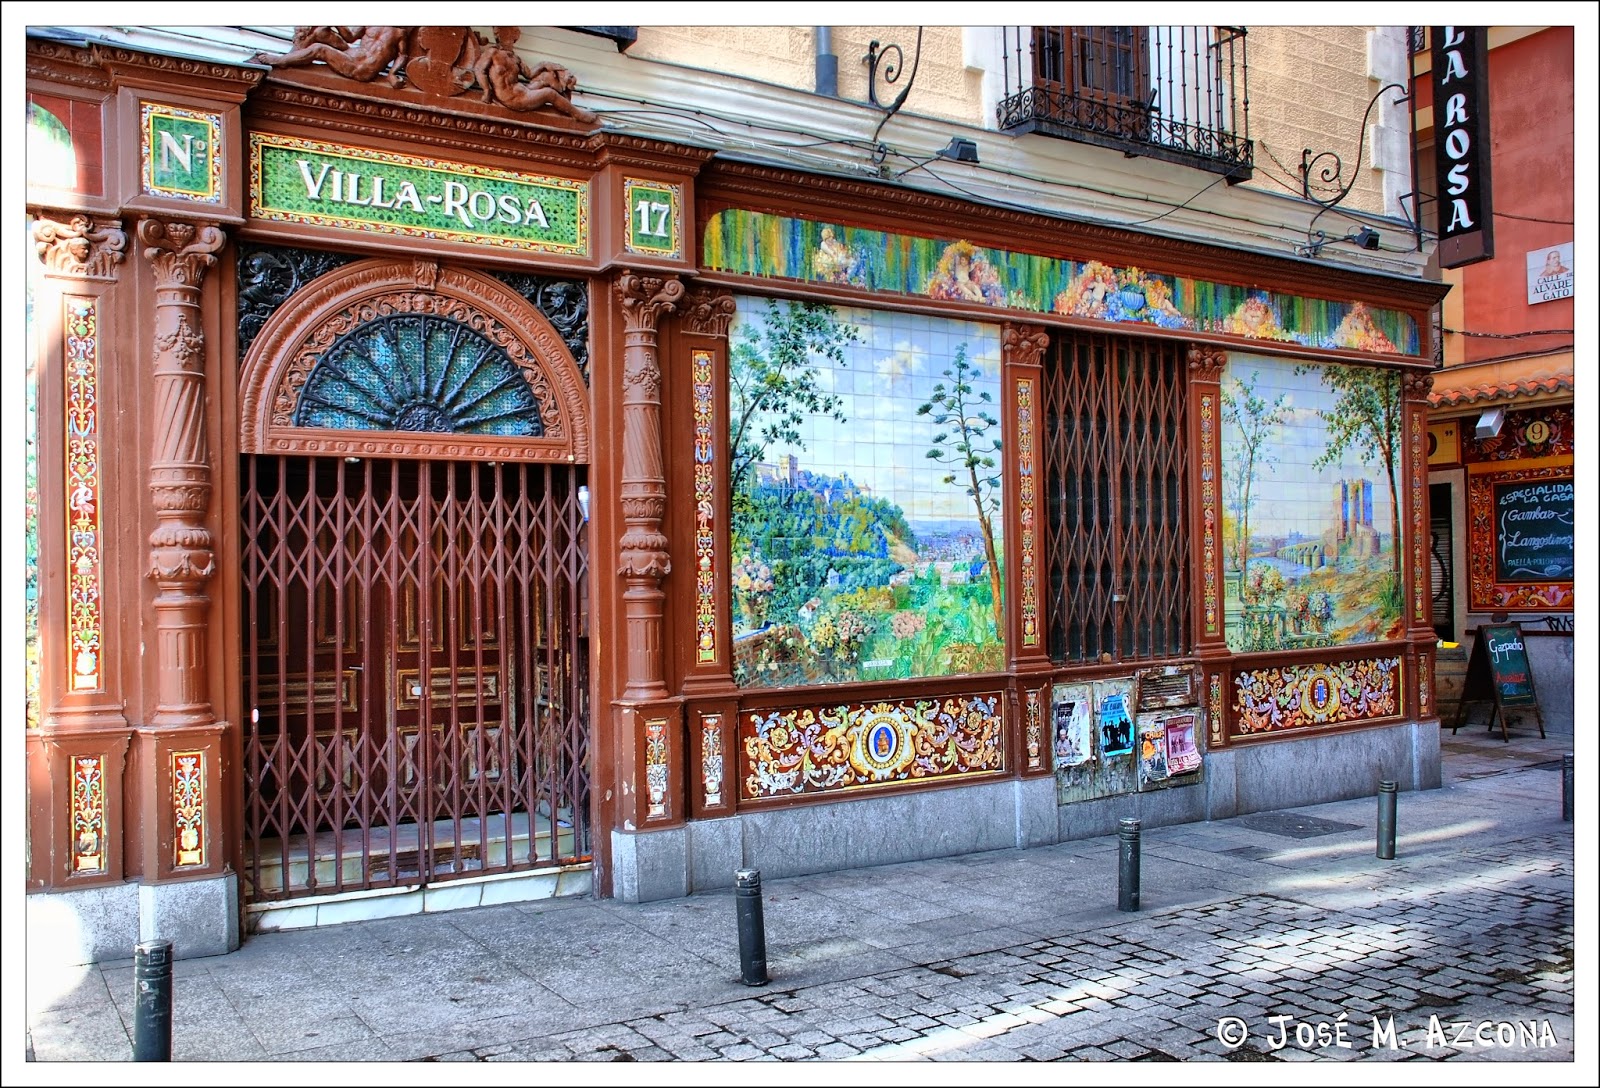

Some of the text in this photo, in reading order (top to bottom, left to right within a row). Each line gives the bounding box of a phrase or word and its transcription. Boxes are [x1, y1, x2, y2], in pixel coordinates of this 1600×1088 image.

[1444, 93, 1474, 232] ROSA
[296, 159, 551, 229] VILLA-ROSA
[635, 200, 670, 239] 17
[1537, 274, 1561, 285] CALLE
[1543, 289, 1570, 300] GATO
[1531, 423, 1543, 440] 9
[1523, 493, 1573, 504] LA CASA
[1488, 637, 1524, 663] Gazpacho
